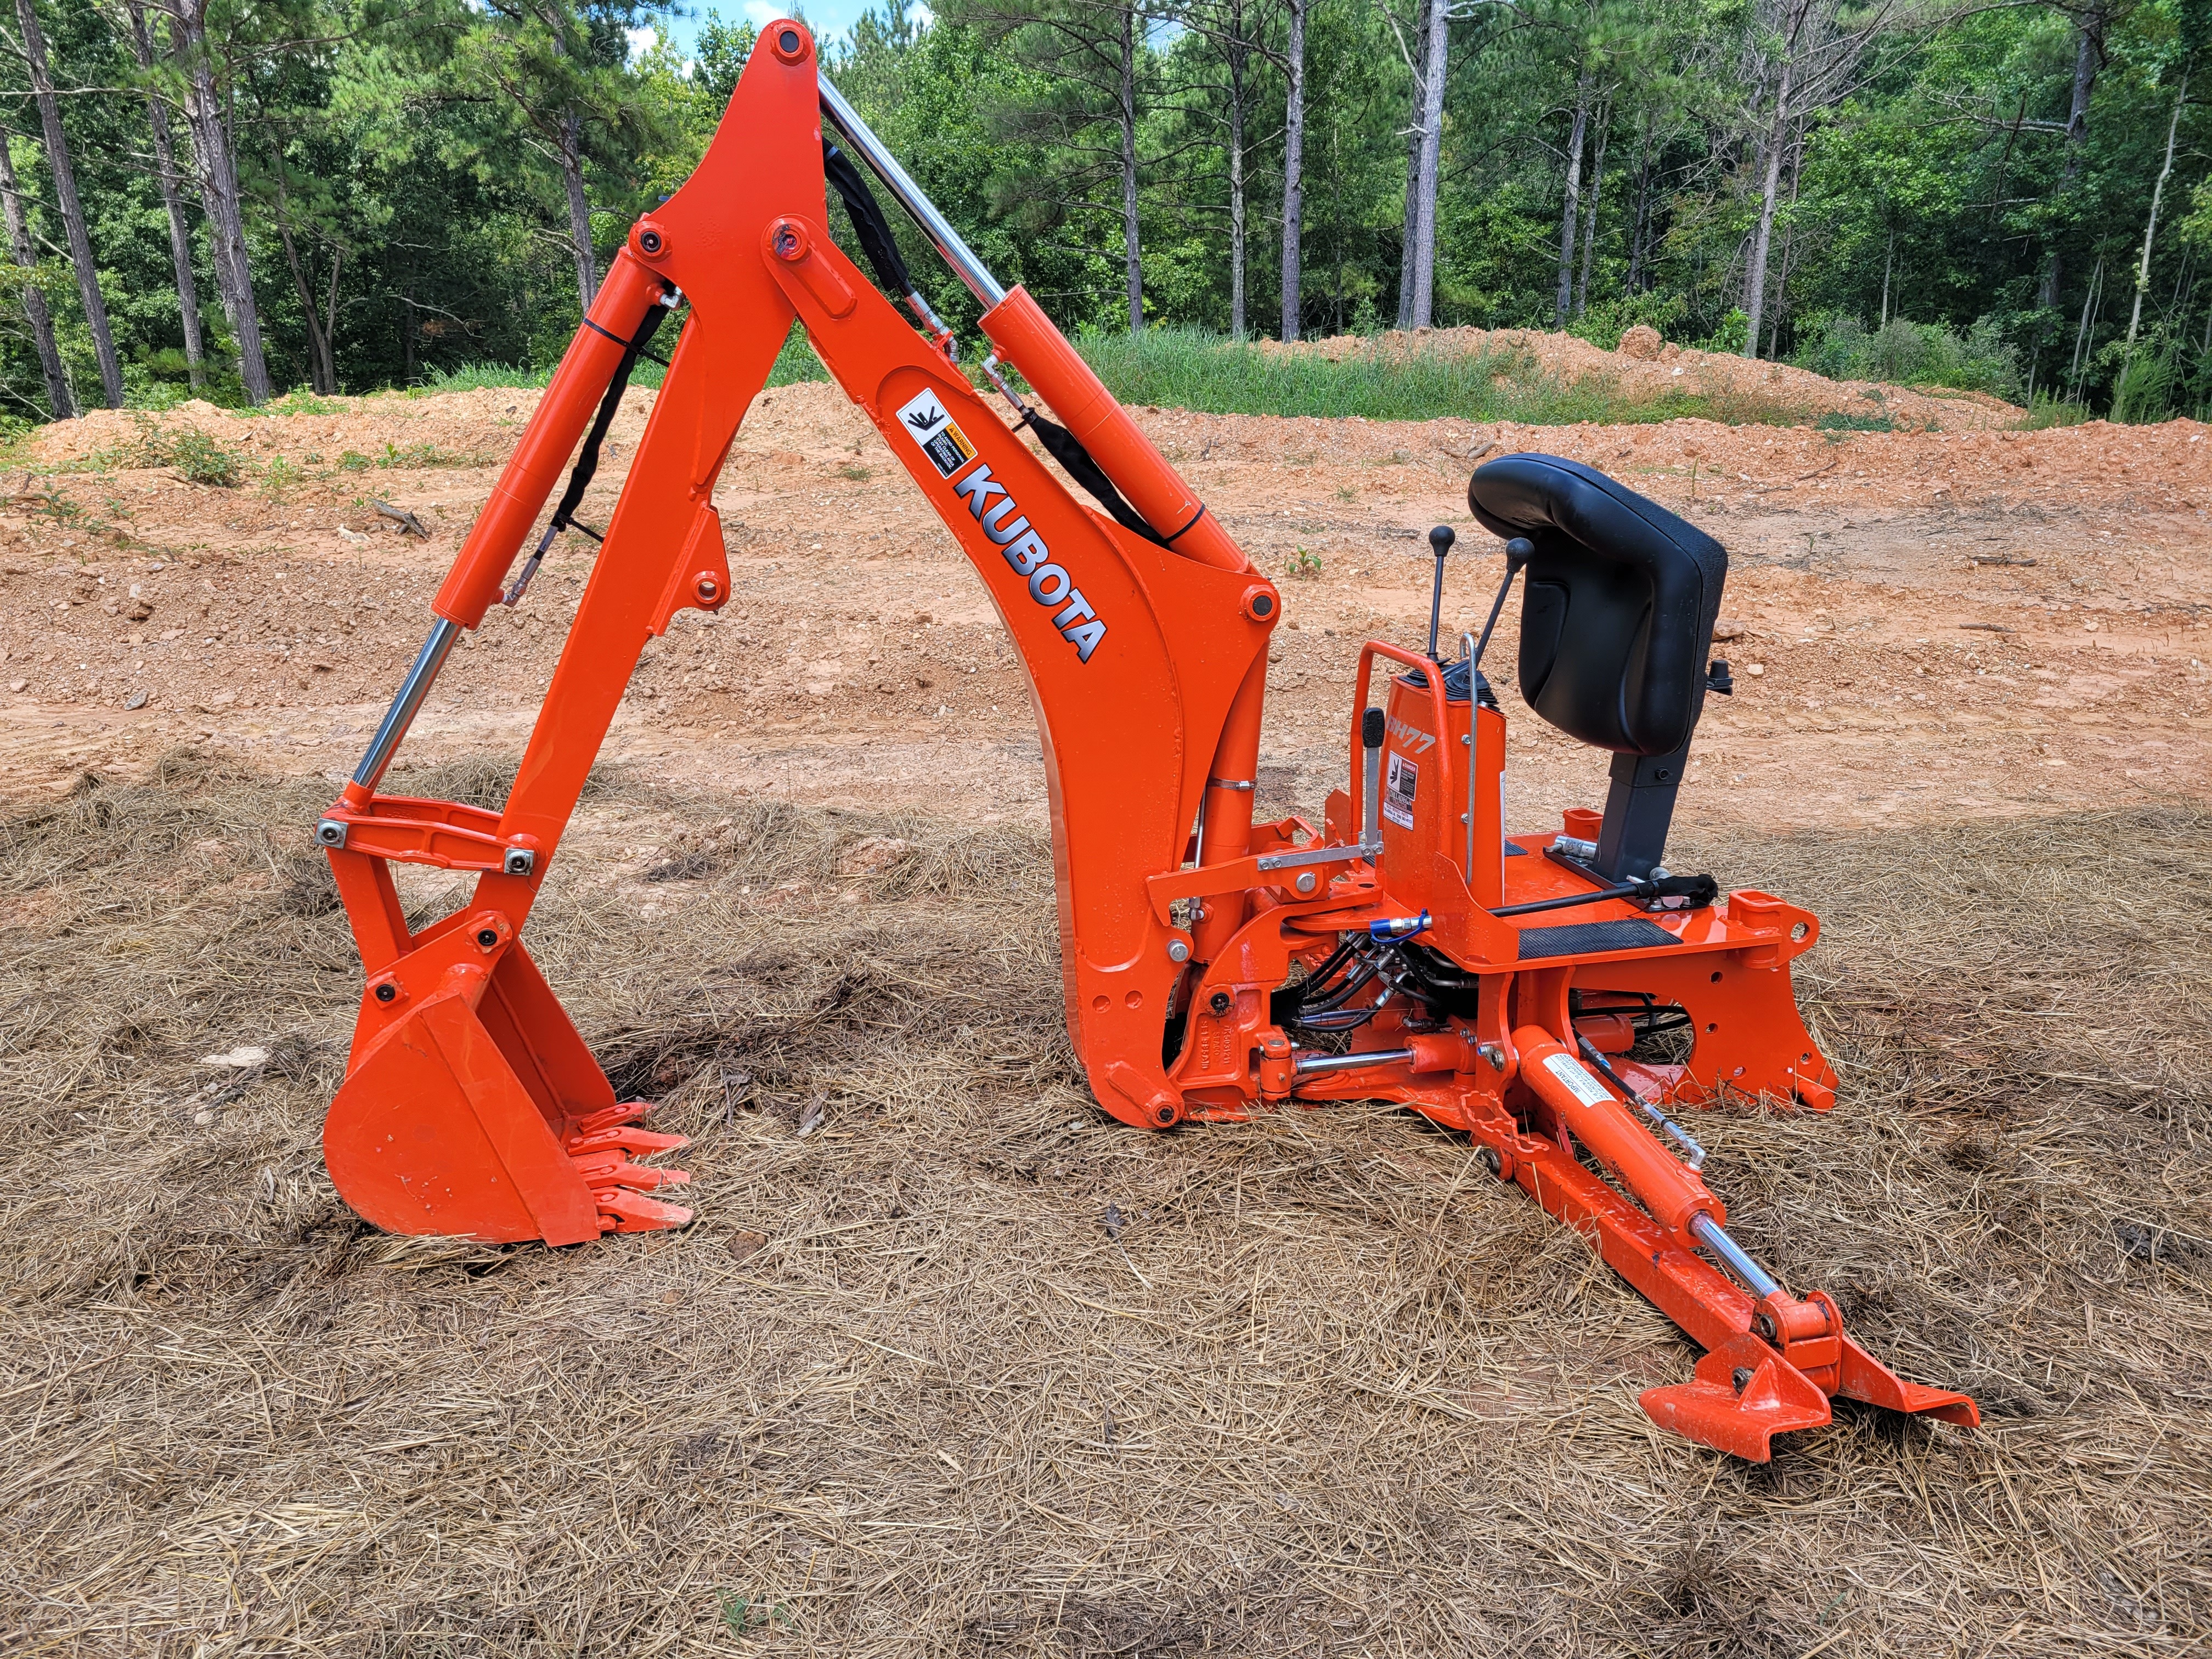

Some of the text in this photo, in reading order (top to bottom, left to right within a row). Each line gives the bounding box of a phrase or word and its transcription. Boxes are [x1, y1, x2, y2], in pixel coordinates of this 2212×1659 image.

[934, 440, 948, 458] OPERATING
[943, 446, 951, 457] CLEAR
[944, 437, 952, 446] AVOID
[951, 446, 964, 463] PERSONAL
[953, 431, 972, 455] WARNING
[953, 463, 1107, 664] KUBOTA
[1386, 715, 1435, 754] BH77
[1405, 763, 1415, 771] DANGER
[1390, 790, 1412, 805] TALLADEGA
[1555, 1070, 1581, 1093] IMPORTANT
